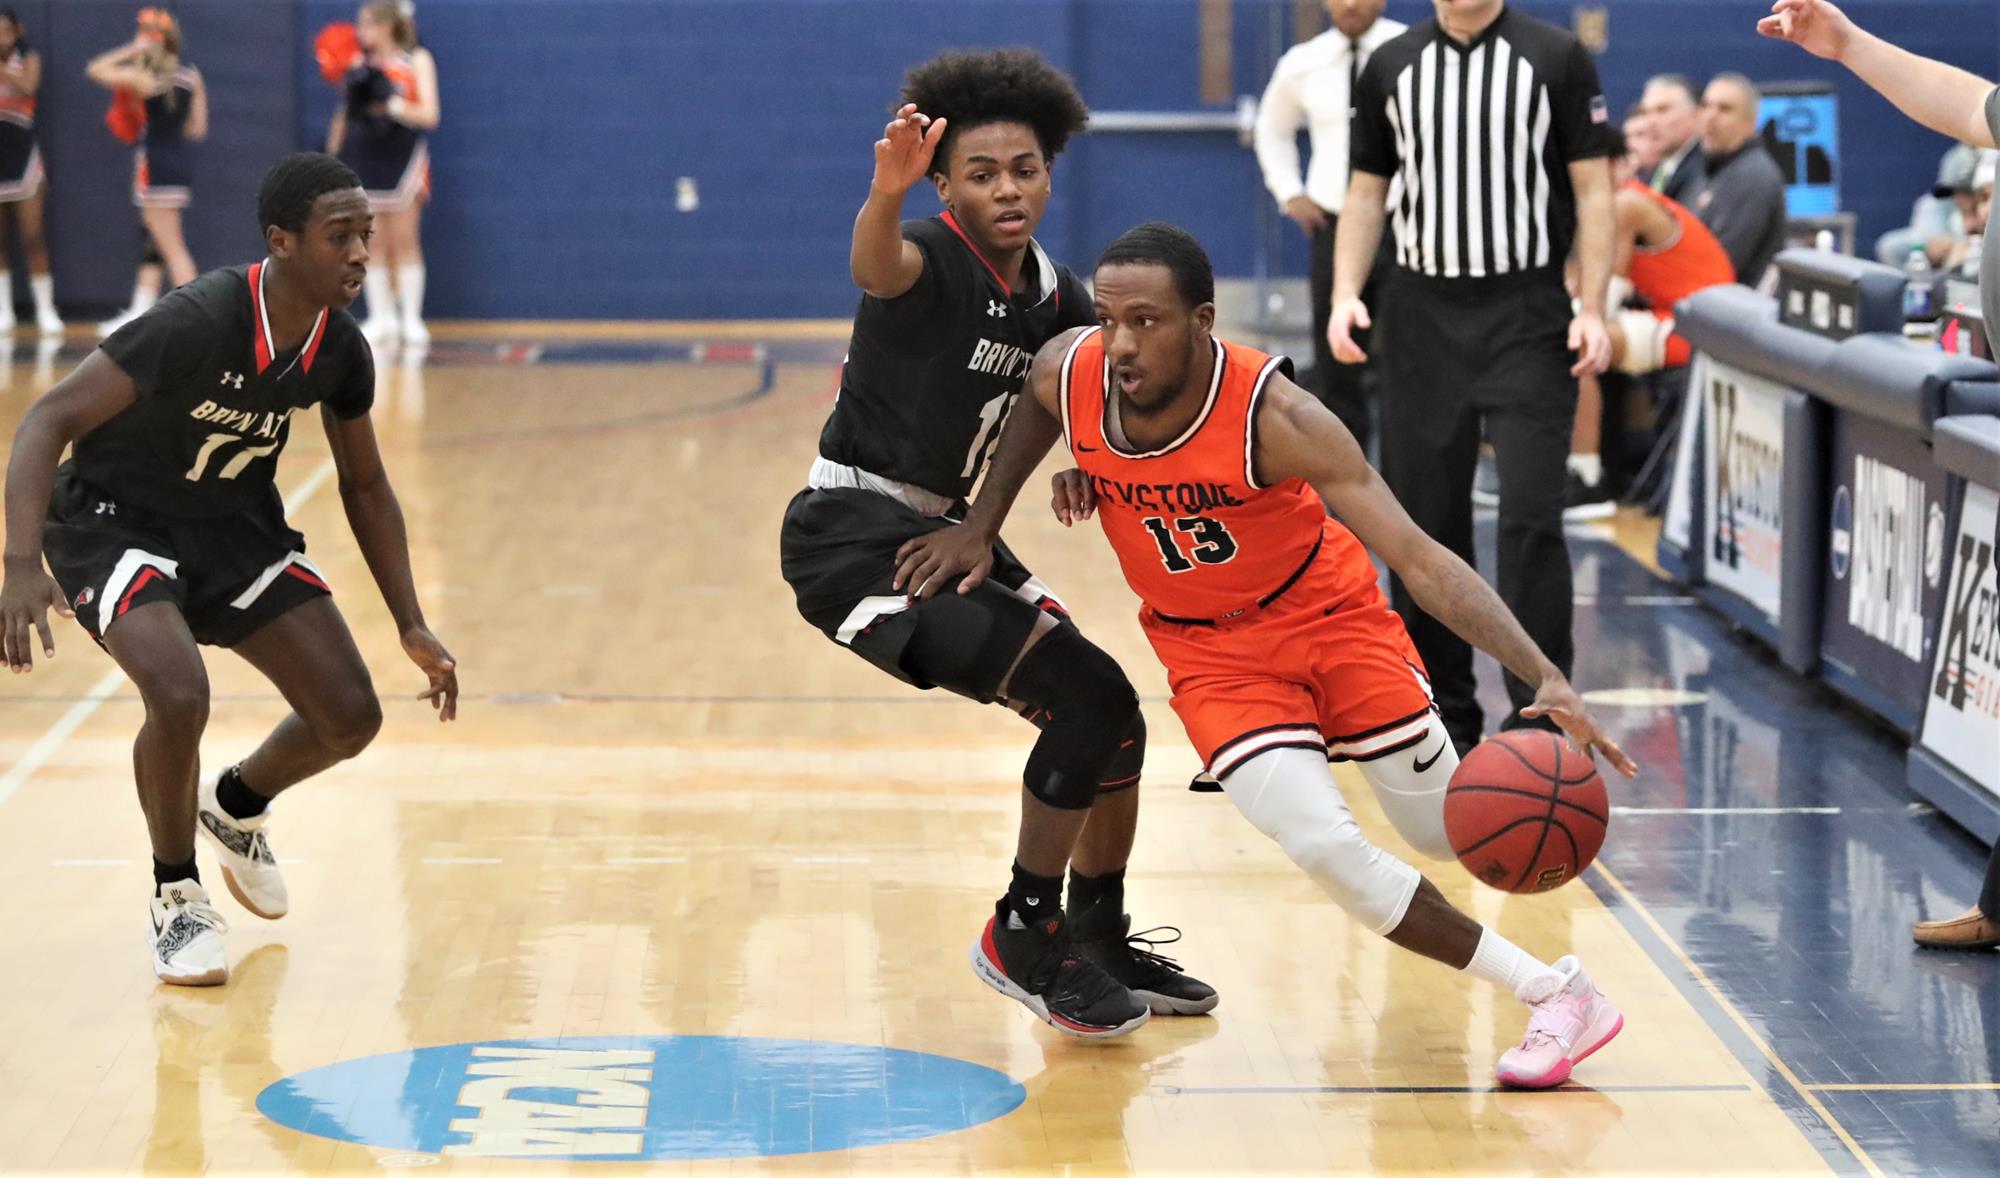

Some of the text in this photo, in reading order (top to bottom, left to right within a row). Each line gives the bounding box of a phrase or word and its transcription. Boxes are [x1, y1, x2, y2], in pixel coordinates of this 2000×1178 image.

[967, 337, 1020, 377] BRYN
[190, 400, 258, 432] BRYN
[1141, 515, 1239, 574] 13
[441, 1045, 656, 1157] NCAA
